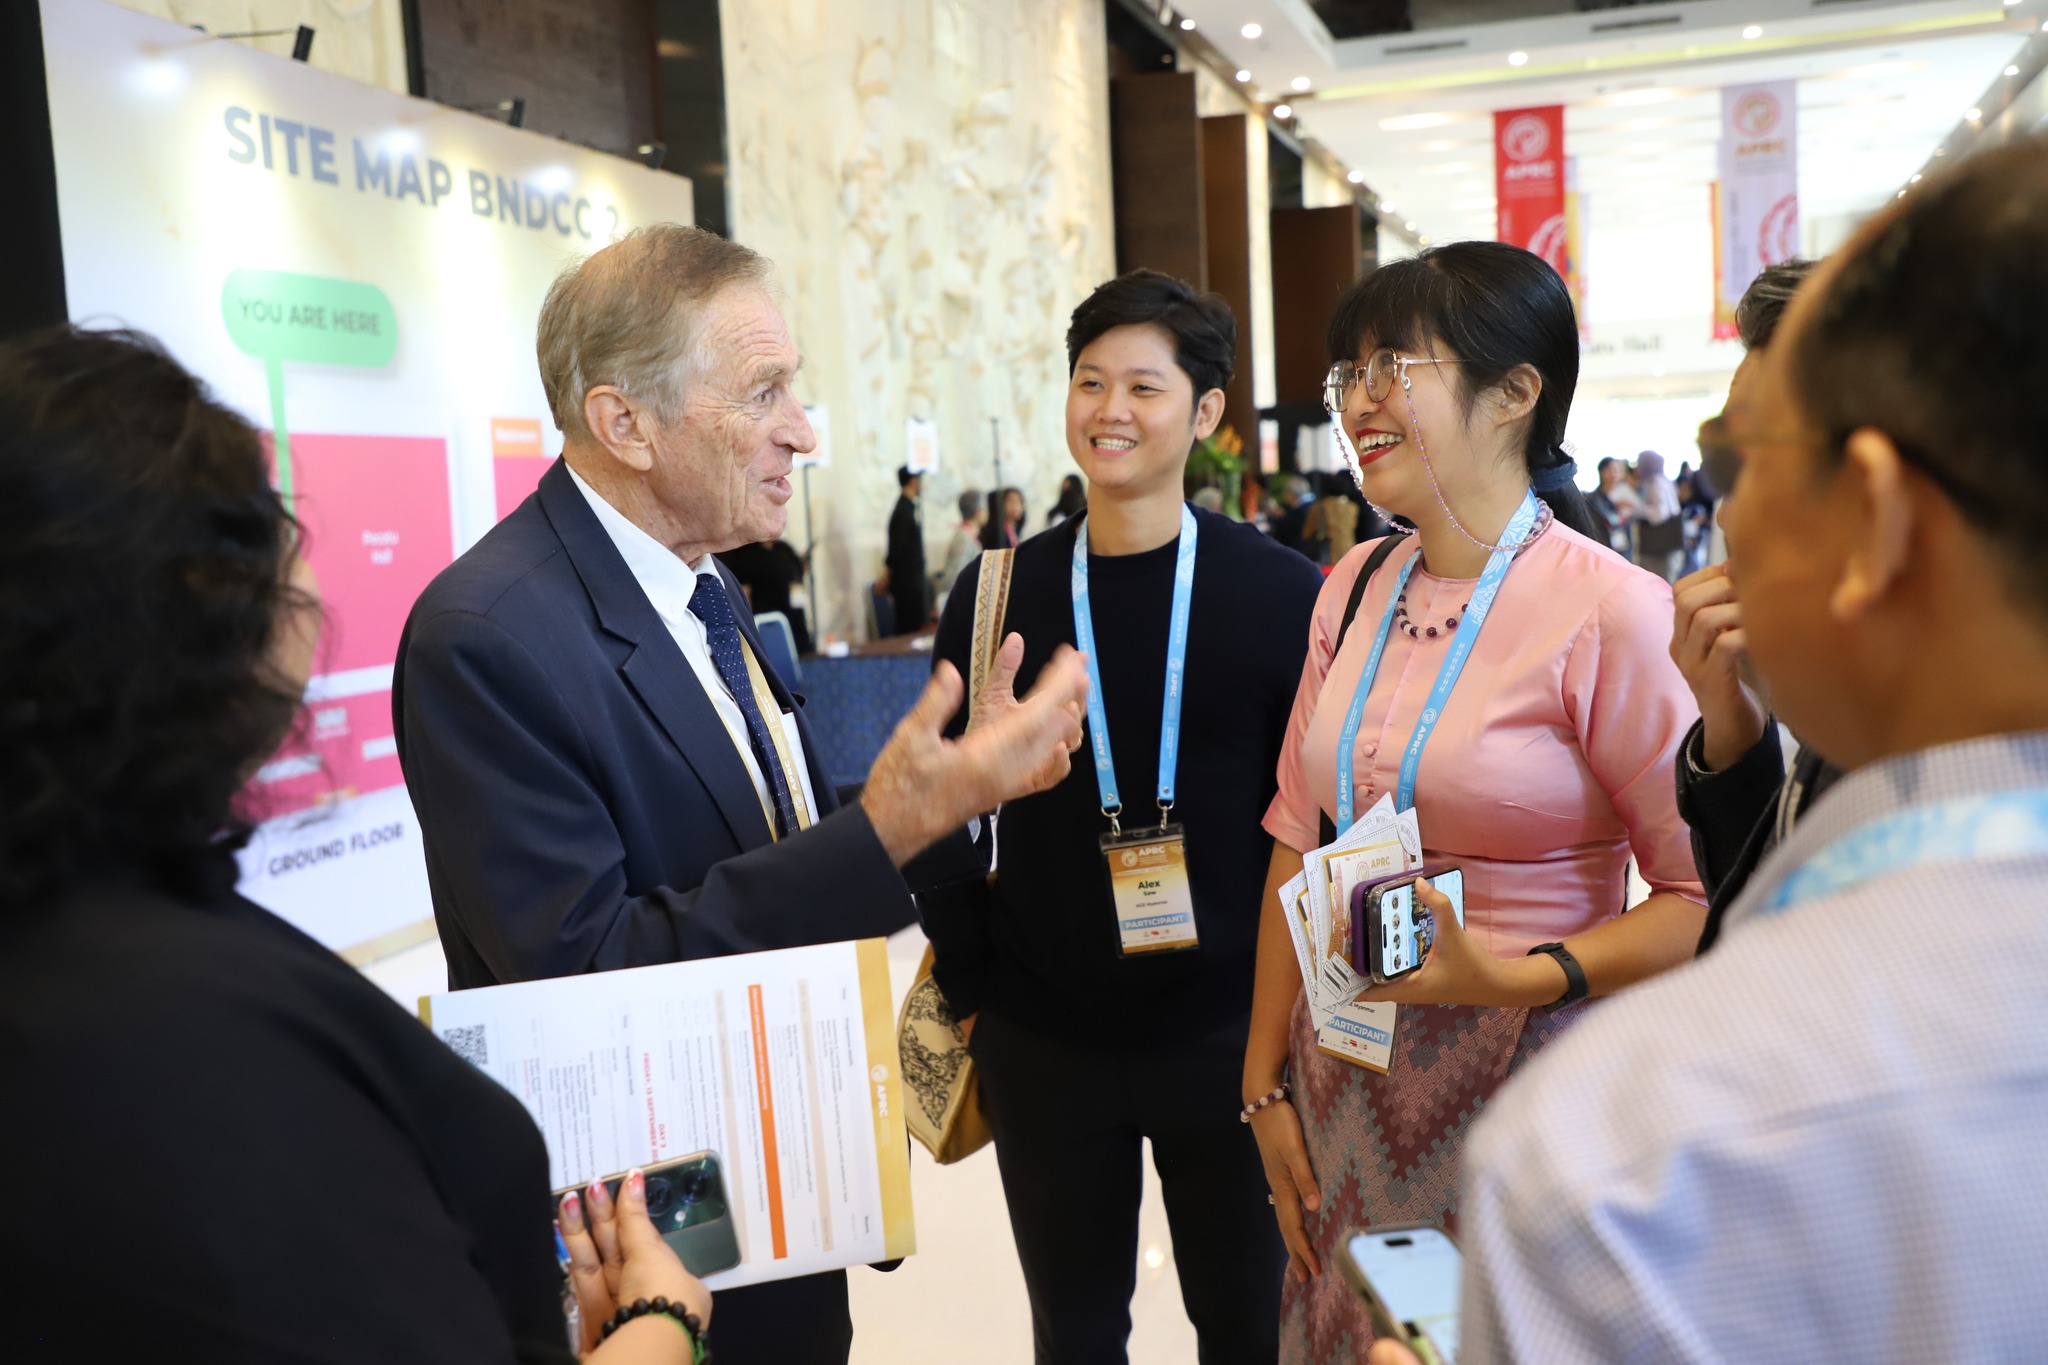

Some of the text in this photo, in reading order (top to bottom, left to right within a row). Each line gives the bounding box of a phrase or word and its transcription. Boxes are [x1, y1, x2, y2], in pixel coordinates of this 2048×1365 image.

[223, 105, 339, 186] SITE
[352, 138, 452, 207] MAP
[469, 169, 592, 239] BNDCC
[240, 297, 381, 337] YOU ARE HERE
[1169, 672, 1178, 697] APRC
[1097, 732, 1105, 757] APRC
[1409, 724, 1427, 756] APRC
[270, 823, 403, 877] GROUND FLOOR
[1139, 846, 1165, 856] APRC
[1370, 855, 1390, 869] APRC
[1138, 879, 1161, 890] Alex
[1125, 915, 1185, 929] PARTICIPANT
[1354, 1003, 1375, 1013] Myanmar
[1329, 1018, 1386, 1042] PARTICIPANT
[877, 1083, 888, 1117] APRC
[647, 1097, 657, 1146] SEPTEMBER
